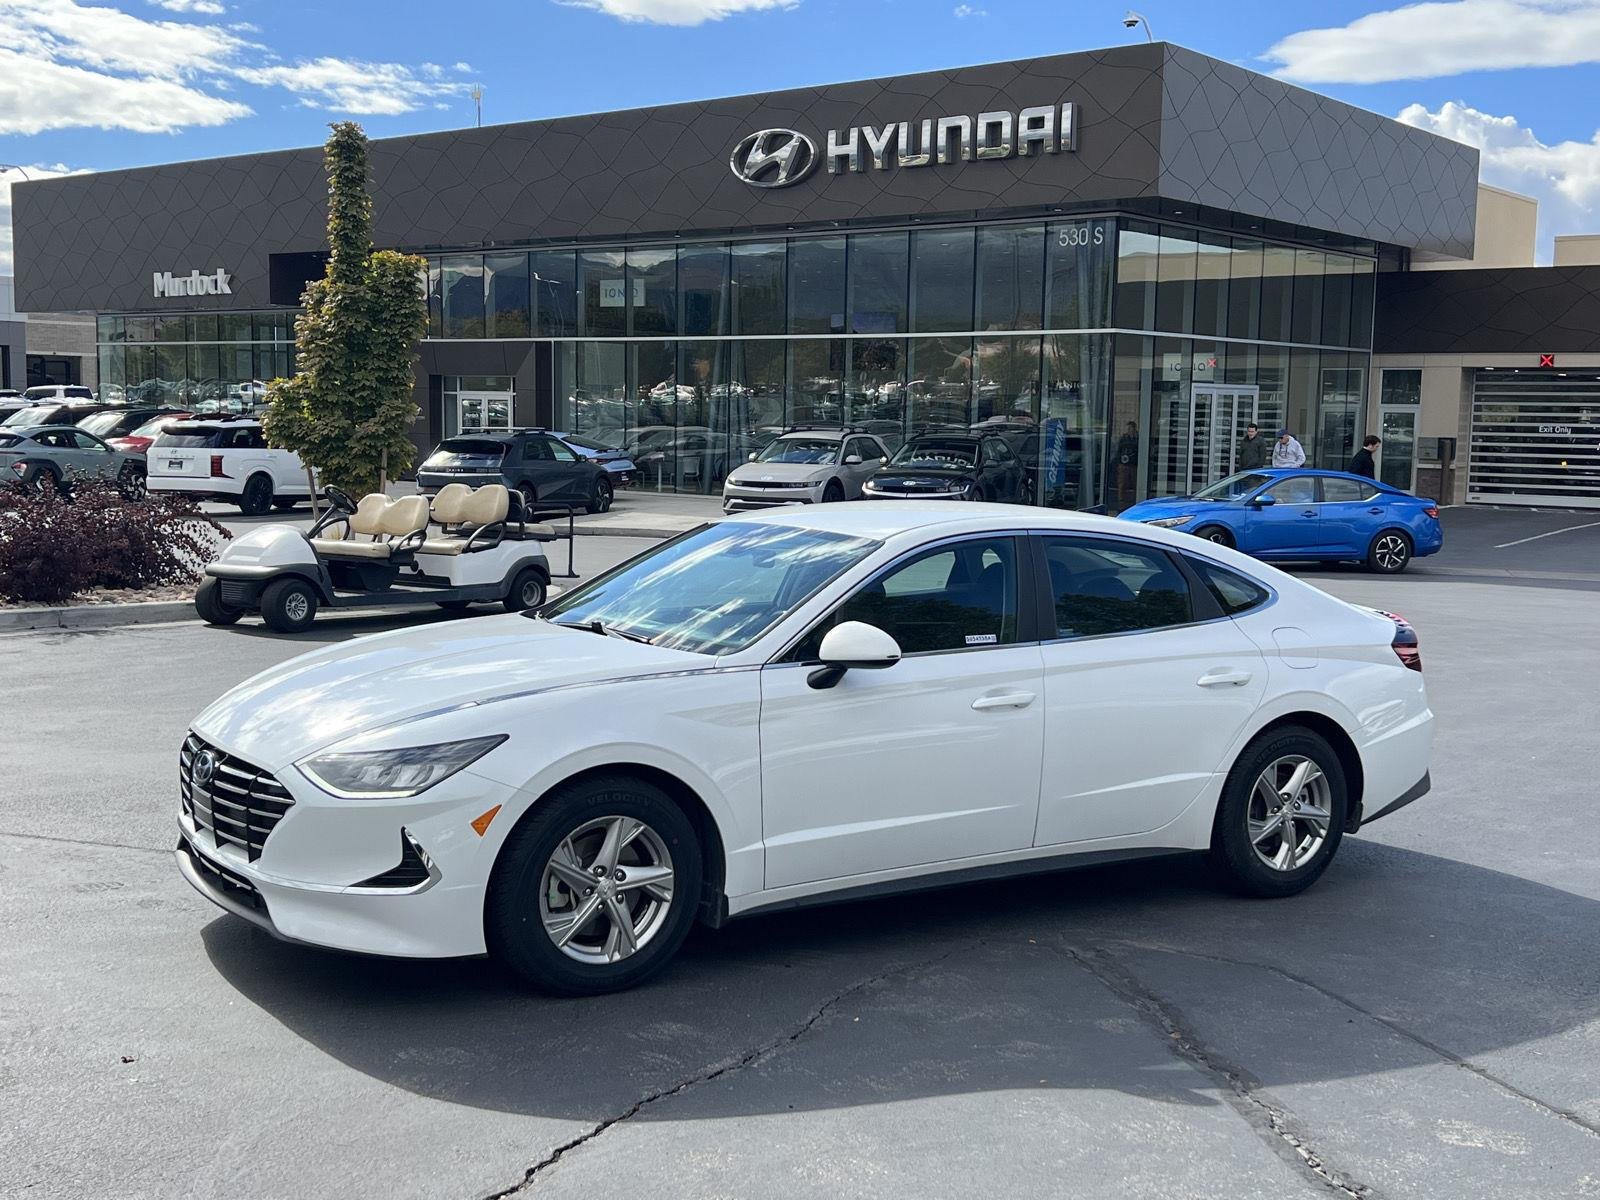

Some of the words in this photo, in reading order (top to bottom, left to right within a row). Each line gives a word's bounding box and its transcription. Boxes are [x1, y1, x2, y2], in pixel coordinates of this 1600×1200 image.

[827, 102, 1077, 174] HYUNDAI
[1059, 228, 1089, 247] 530
[1093, 226, 1104, 245] S
[153, 268, 232, 297] Murdock
[604, 288, 639, 299] IONQ
[1538, 425, 1553, 434] Exit
[1554, 425, 1572, 436] Only
[586, 791, 653, 806] VELOCITY
